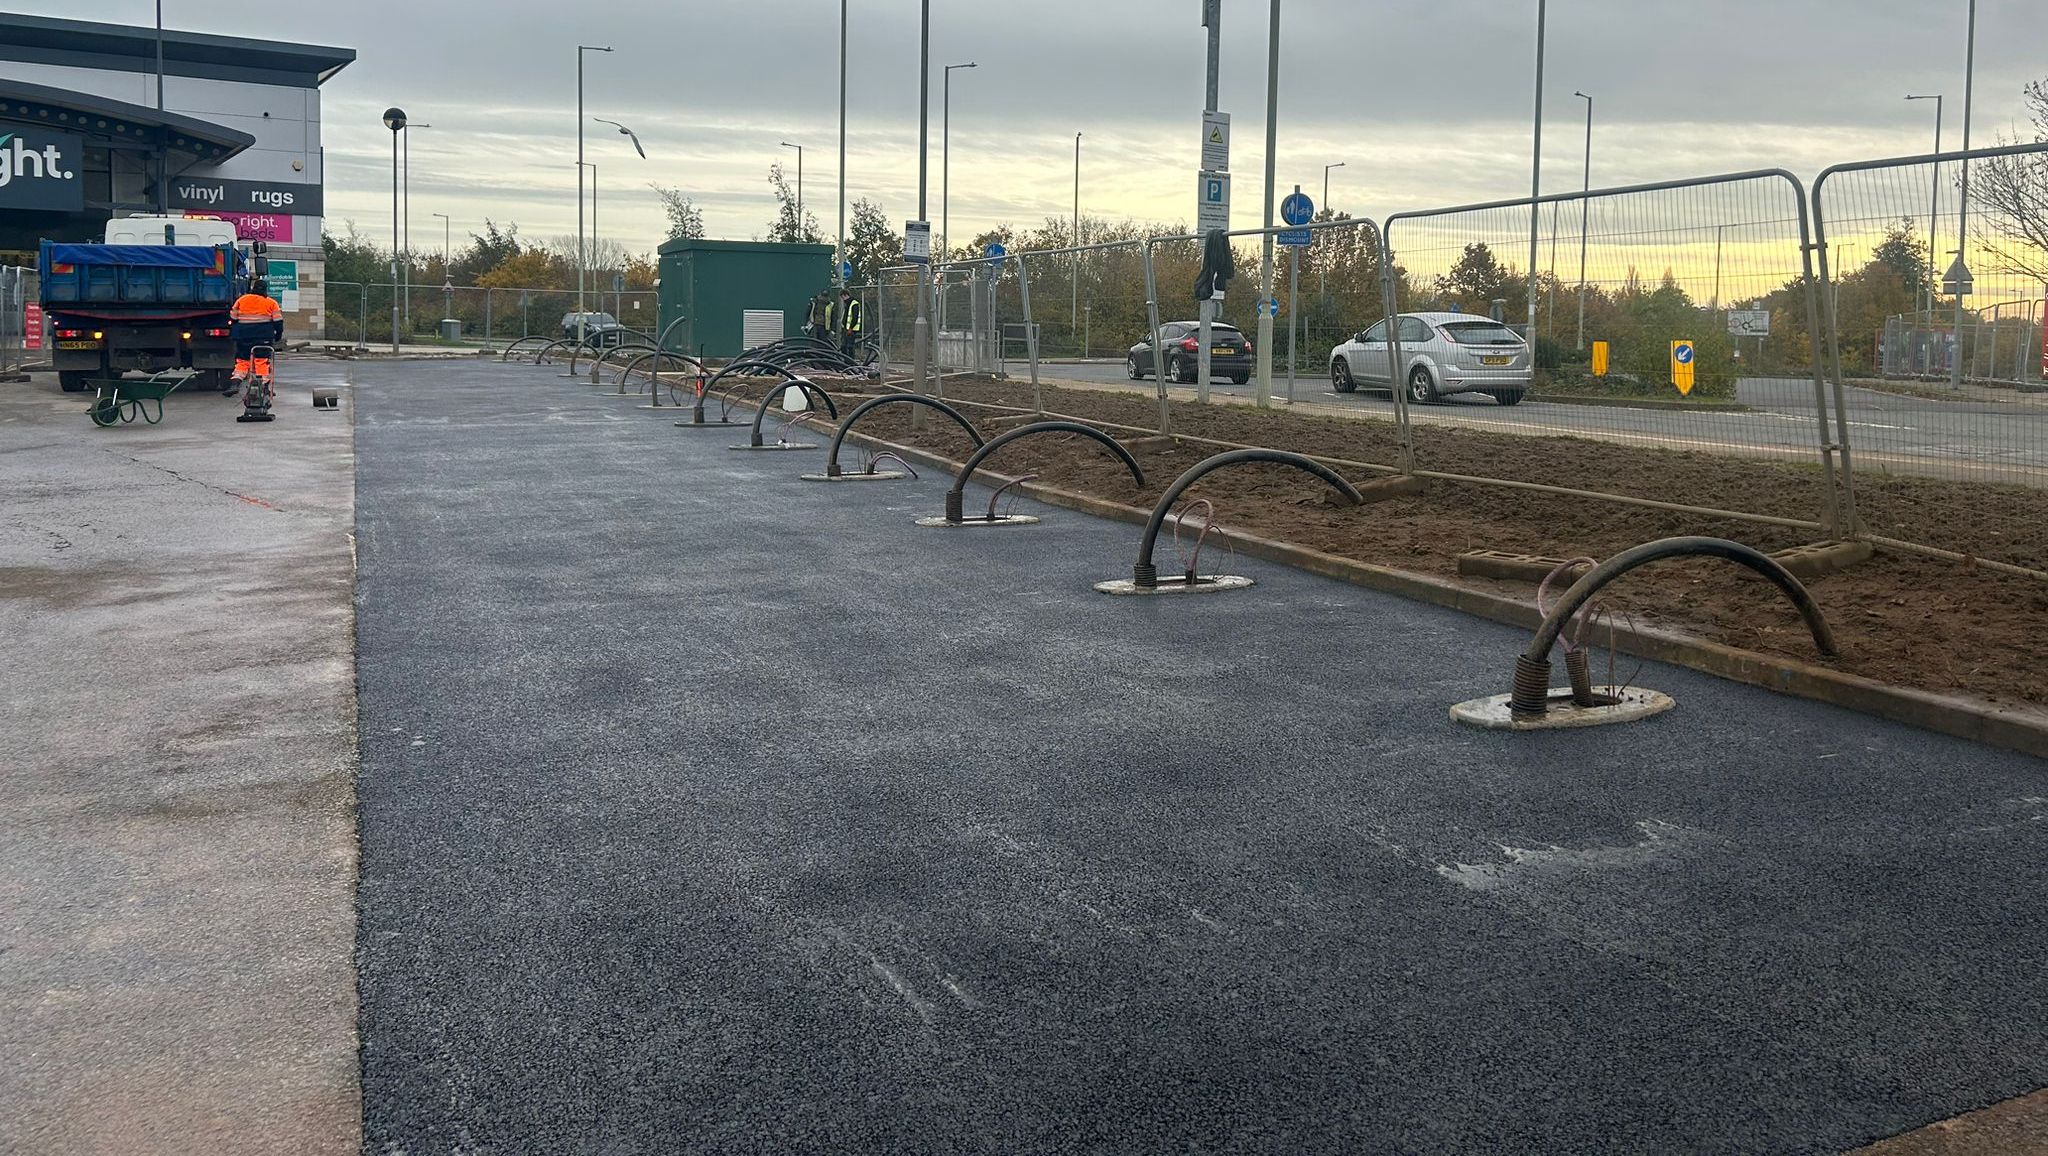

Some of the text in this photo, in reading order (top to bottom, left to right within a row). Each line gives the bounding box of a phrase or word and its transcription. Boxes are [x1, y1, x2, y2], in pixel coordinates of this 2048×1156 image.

[179, 184, 294, 207] vinyl rugs
[1210, 183, 1219, 199] P
[240, 227, 275, 240] beds
